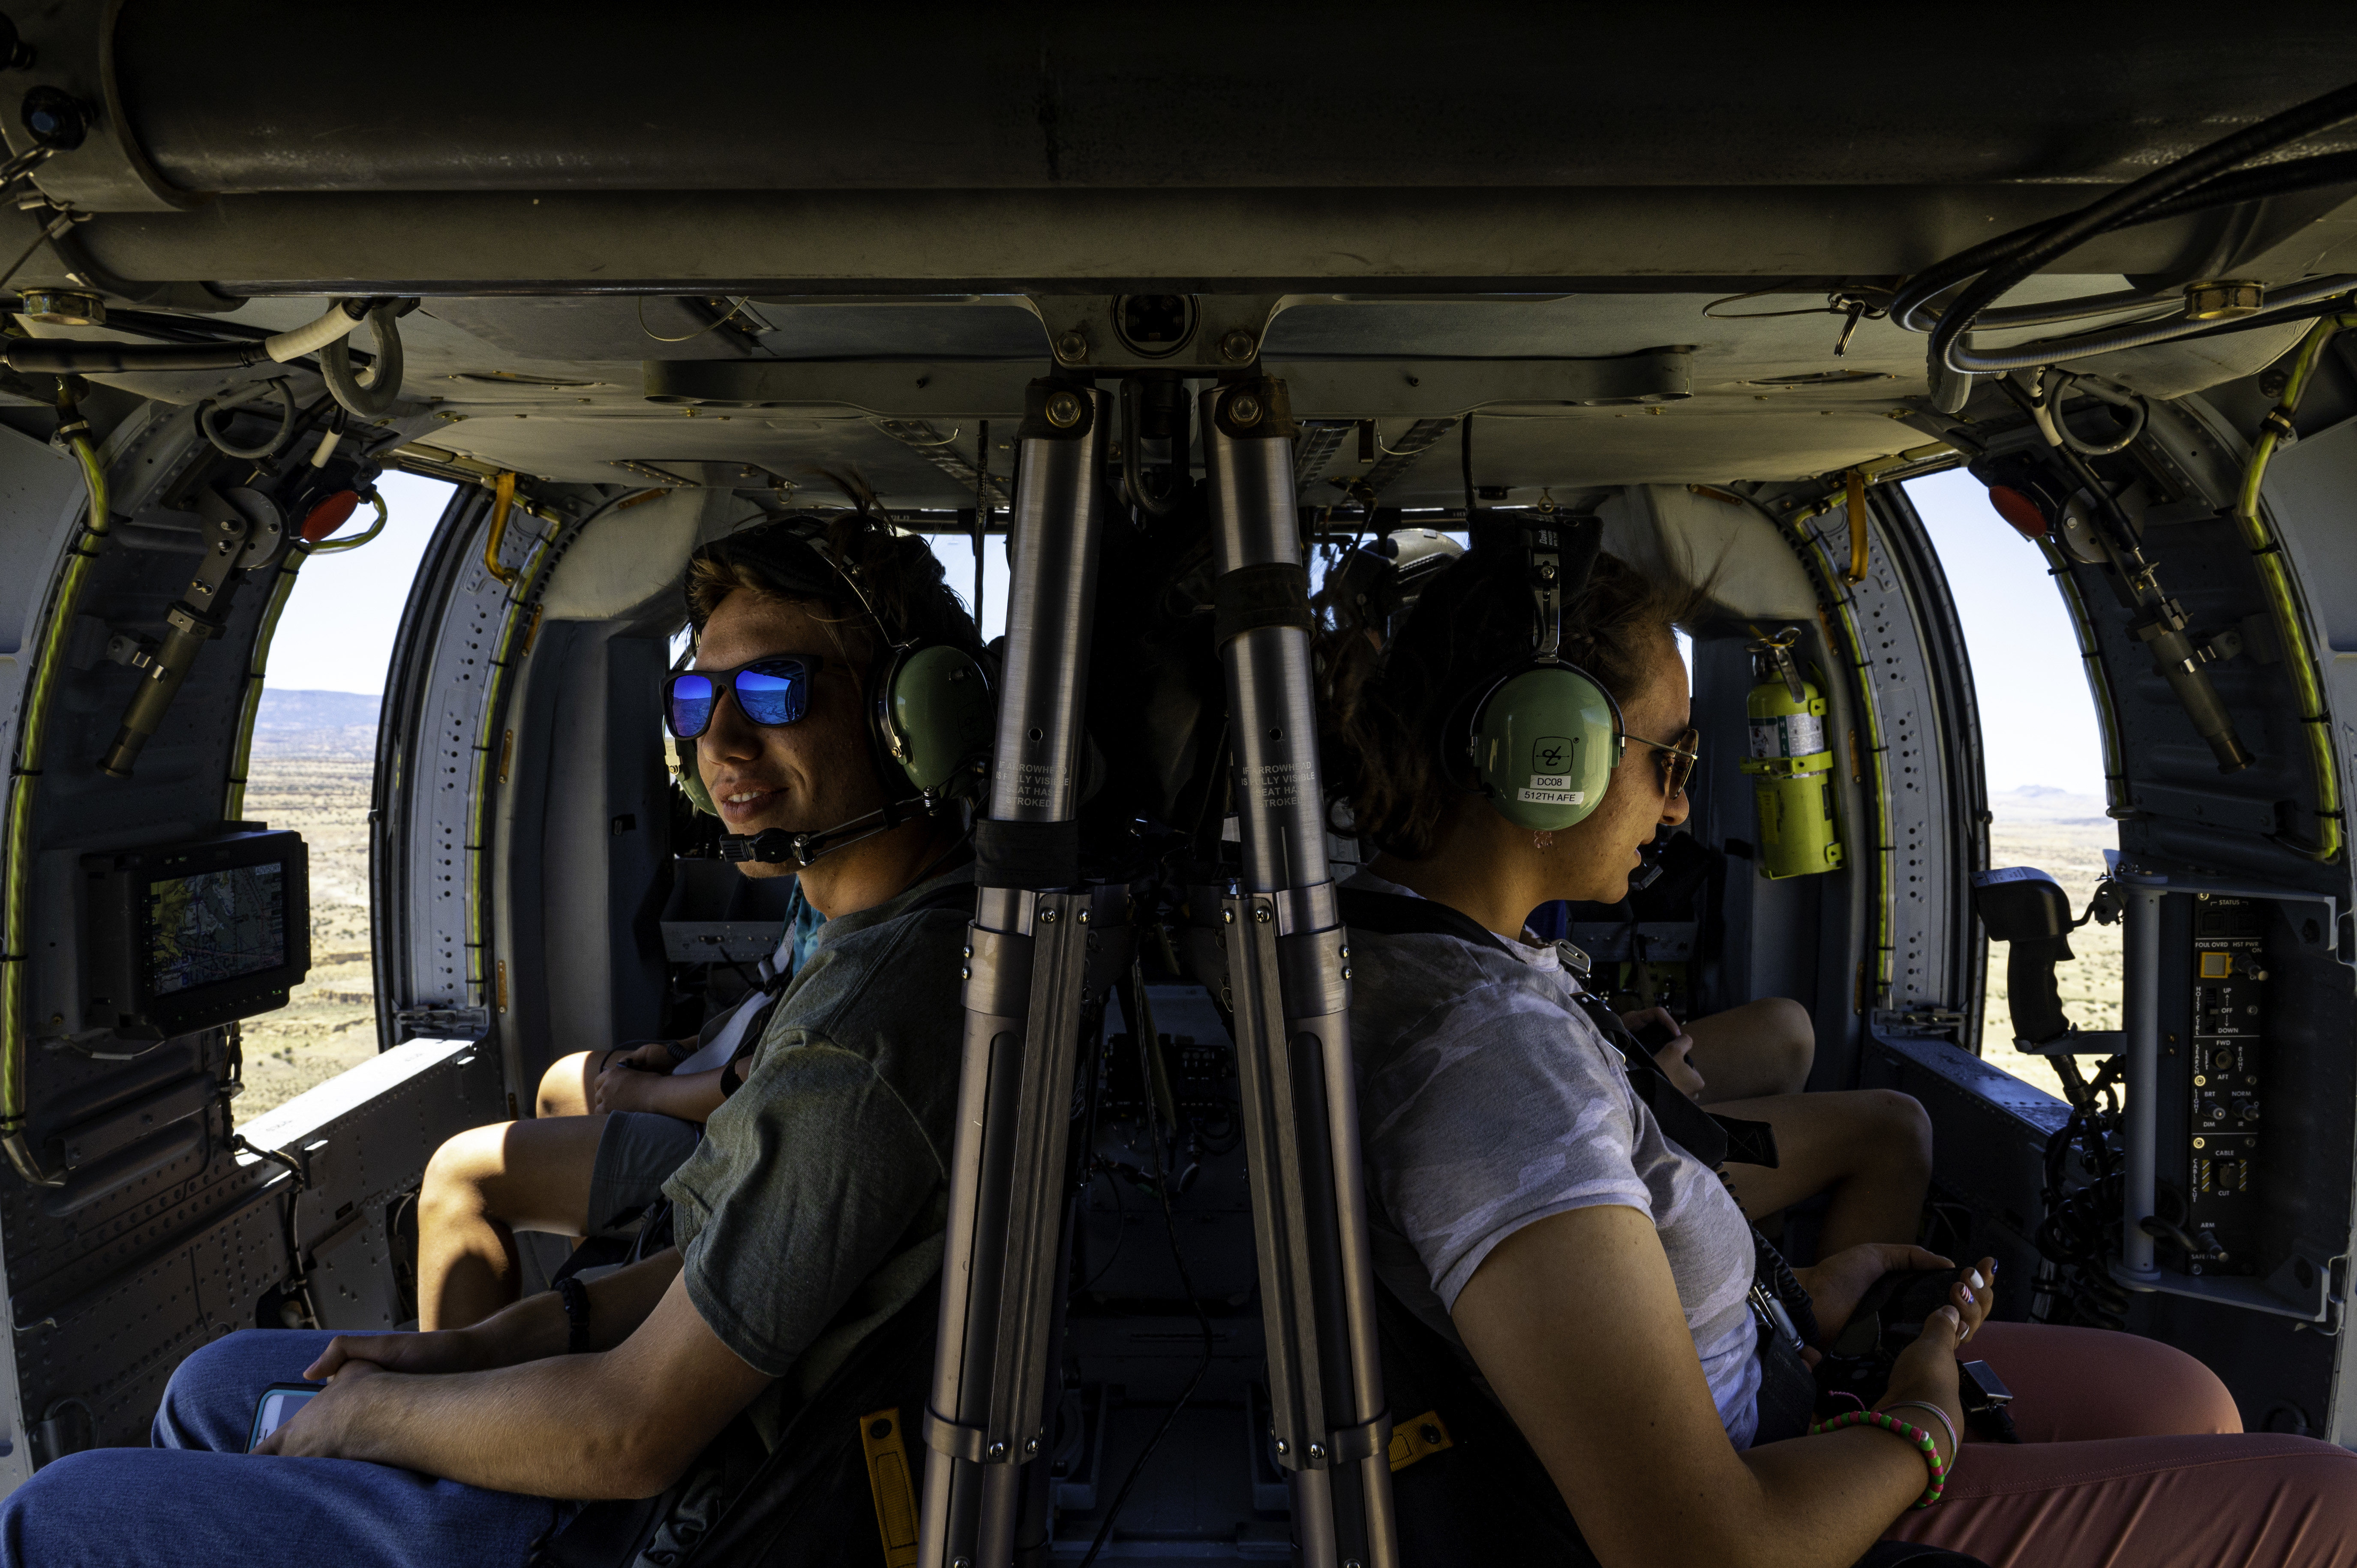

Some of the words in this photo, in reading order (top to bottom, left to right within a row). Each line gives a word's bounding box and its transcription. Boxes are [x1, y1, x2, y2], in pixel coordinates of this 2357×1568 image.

[999, 760, 1005, 768] IF
[1007, 762, 1067, 774] ARROWHEAD
[1243, 767, 1249, 775] IF
[1252, 761, 1311, 774] ARROWHEAD
[996, 771, 1001, 779] IS
[1003, 773, 1031, 783] FLY
[1035, 776, 1069, 786] VISIBE
[1241, 778, 1248, 786] IS
[1283, 771, 1315, 783] VISIBLE
[1537, 778, 1562, 786] DC08
[1034, 787, 1053, 796] HAS
[1256, 787, 1281, 796] SEAT
[1284, 785, 1304, 794] HAS
[1524, 791, 1554, 801] 512TH
[1006, 796, 1052, 807] STROKED
